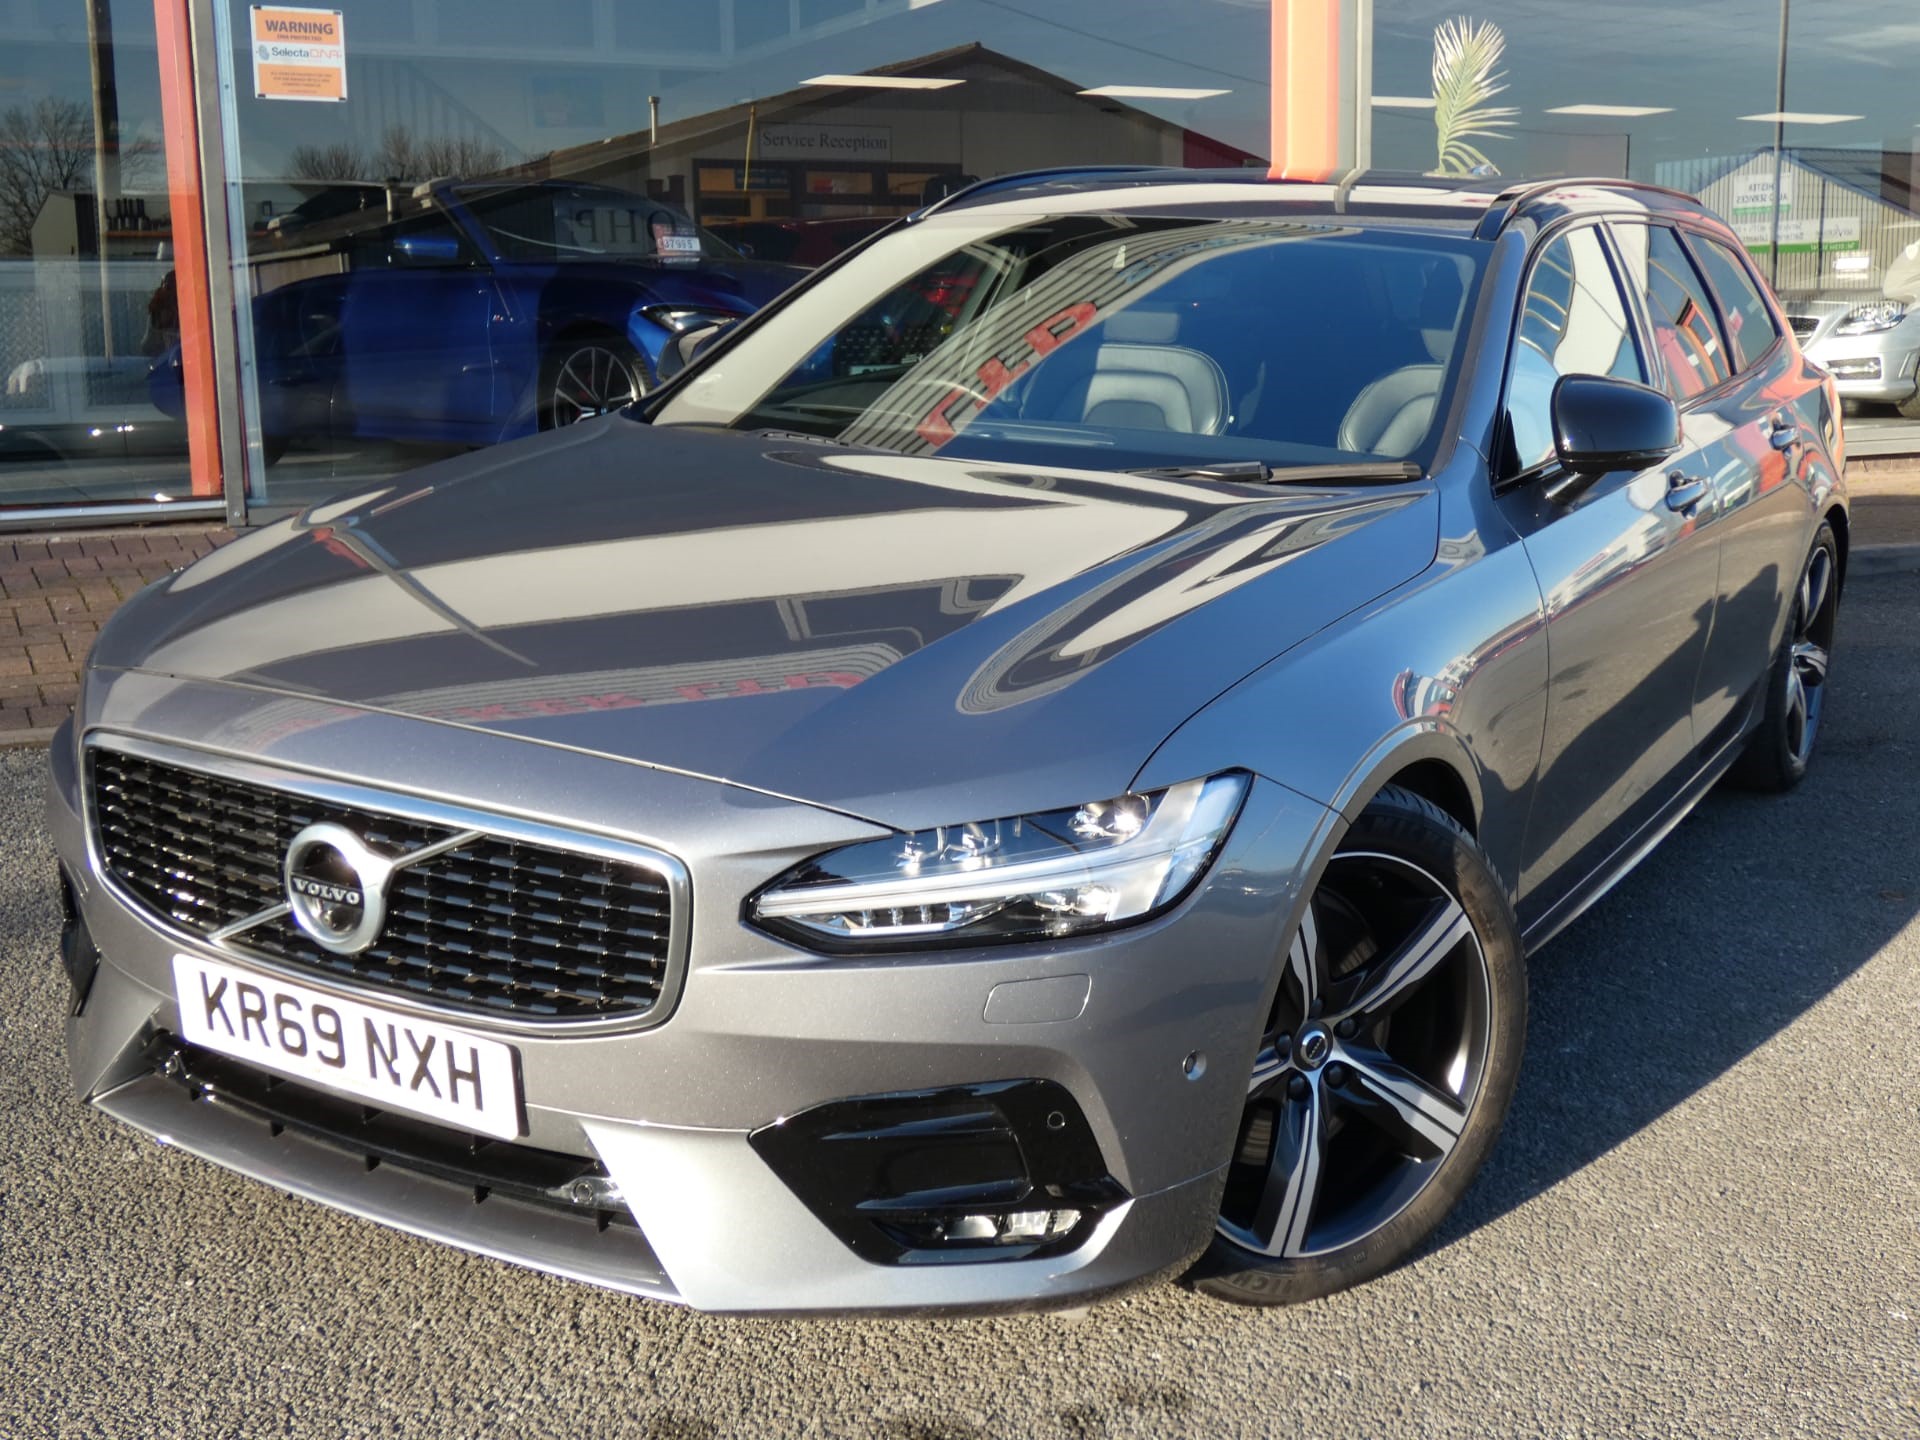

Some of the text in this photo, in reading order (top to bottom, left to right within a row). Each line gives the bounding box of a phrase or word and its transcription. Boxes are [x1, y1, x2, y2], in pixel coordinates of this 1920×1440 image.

[265, 20, 334, 35] WARNING
[762, 131, 888, 152] Service Reception
[292, 877, 361, 905] VOLVO
[199, 970, 484, 1112] KR69 NXH
